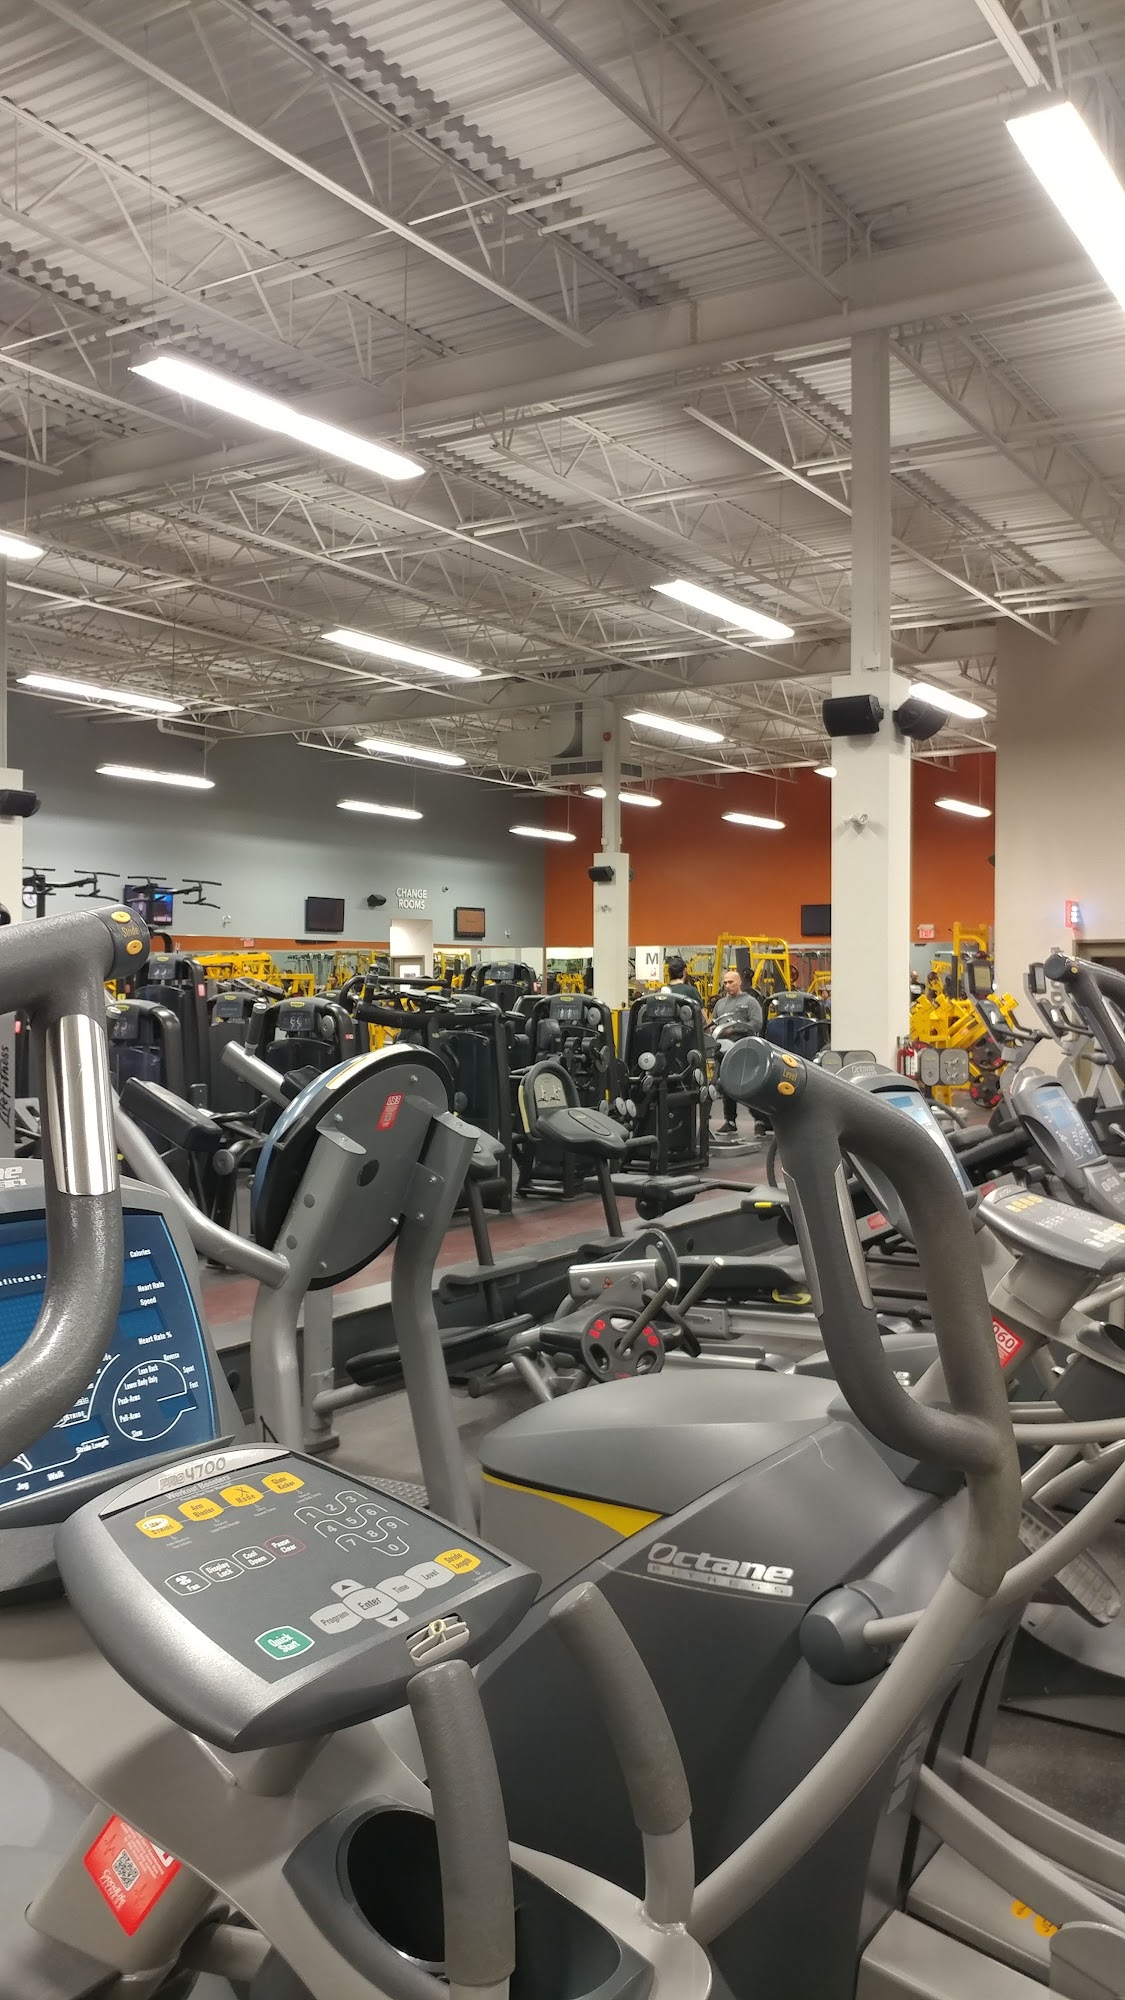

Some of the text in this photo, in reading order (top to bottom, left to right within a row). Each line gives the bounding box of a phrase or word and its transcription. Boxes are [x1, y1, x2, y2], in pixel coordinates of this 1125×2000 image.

[396, 888, 427, 899] CHANGE
[398, 899, 425, 910] ROOMS
[130, 1249, 151, 1258] Calories
[137, 1281, 165, 1292] Heart Rate
[140, 1296, 157, 1306] Speed
[138, 1335, 153, 1345] Heart
[153, 1333, 166, 1342] Rate
[76, 1439, 109, 1454] Stride Length
[47, 1470, 65, 1481] Walk
[16, 1482, 30, 1491] Jog
[165, 1485, 198, 1500] Workout
[196, 1474, 231, 1490] Boosters
[235, 1493, 256, 1504] Mode
[325, 1503, 338, 1512] 2
[345, 1495, 357, 1503] 3
[190, 1502, 204, 1511] Arm
[345, 1516, 357, 1524] 5
[366, 1508, 377, 1516] 6
[345, 1521, 398, 1546] 7 8 9
[271, 1539, 291, 1548] Pause
[280, 1543, 297, 1553] Clear
[387, 1543, 399, 1551] 0
[242, 1550, 258, 1560] Cool
[248, 1555, 268, 1566] Down
[444, 1552, 463, 1564] Stride
[205, 1562, 230, 1574] Display
[451, 1557, 472, 1570] Length
[648, 1543, 794, 1584] Octane
[217, 1568, 234, 1578] Lock
[421, 1569, 440, 1580] Level
[186, 1583, 201, 1592] Fan
[392, 1584, 410, 1594] Time
[358, 1597, 382, 1611] Enter
[320, 1611, 349, 1626] Program
[267, 1633, 294, 1648] Quick
[278, 1640, 301, 1653] Start
